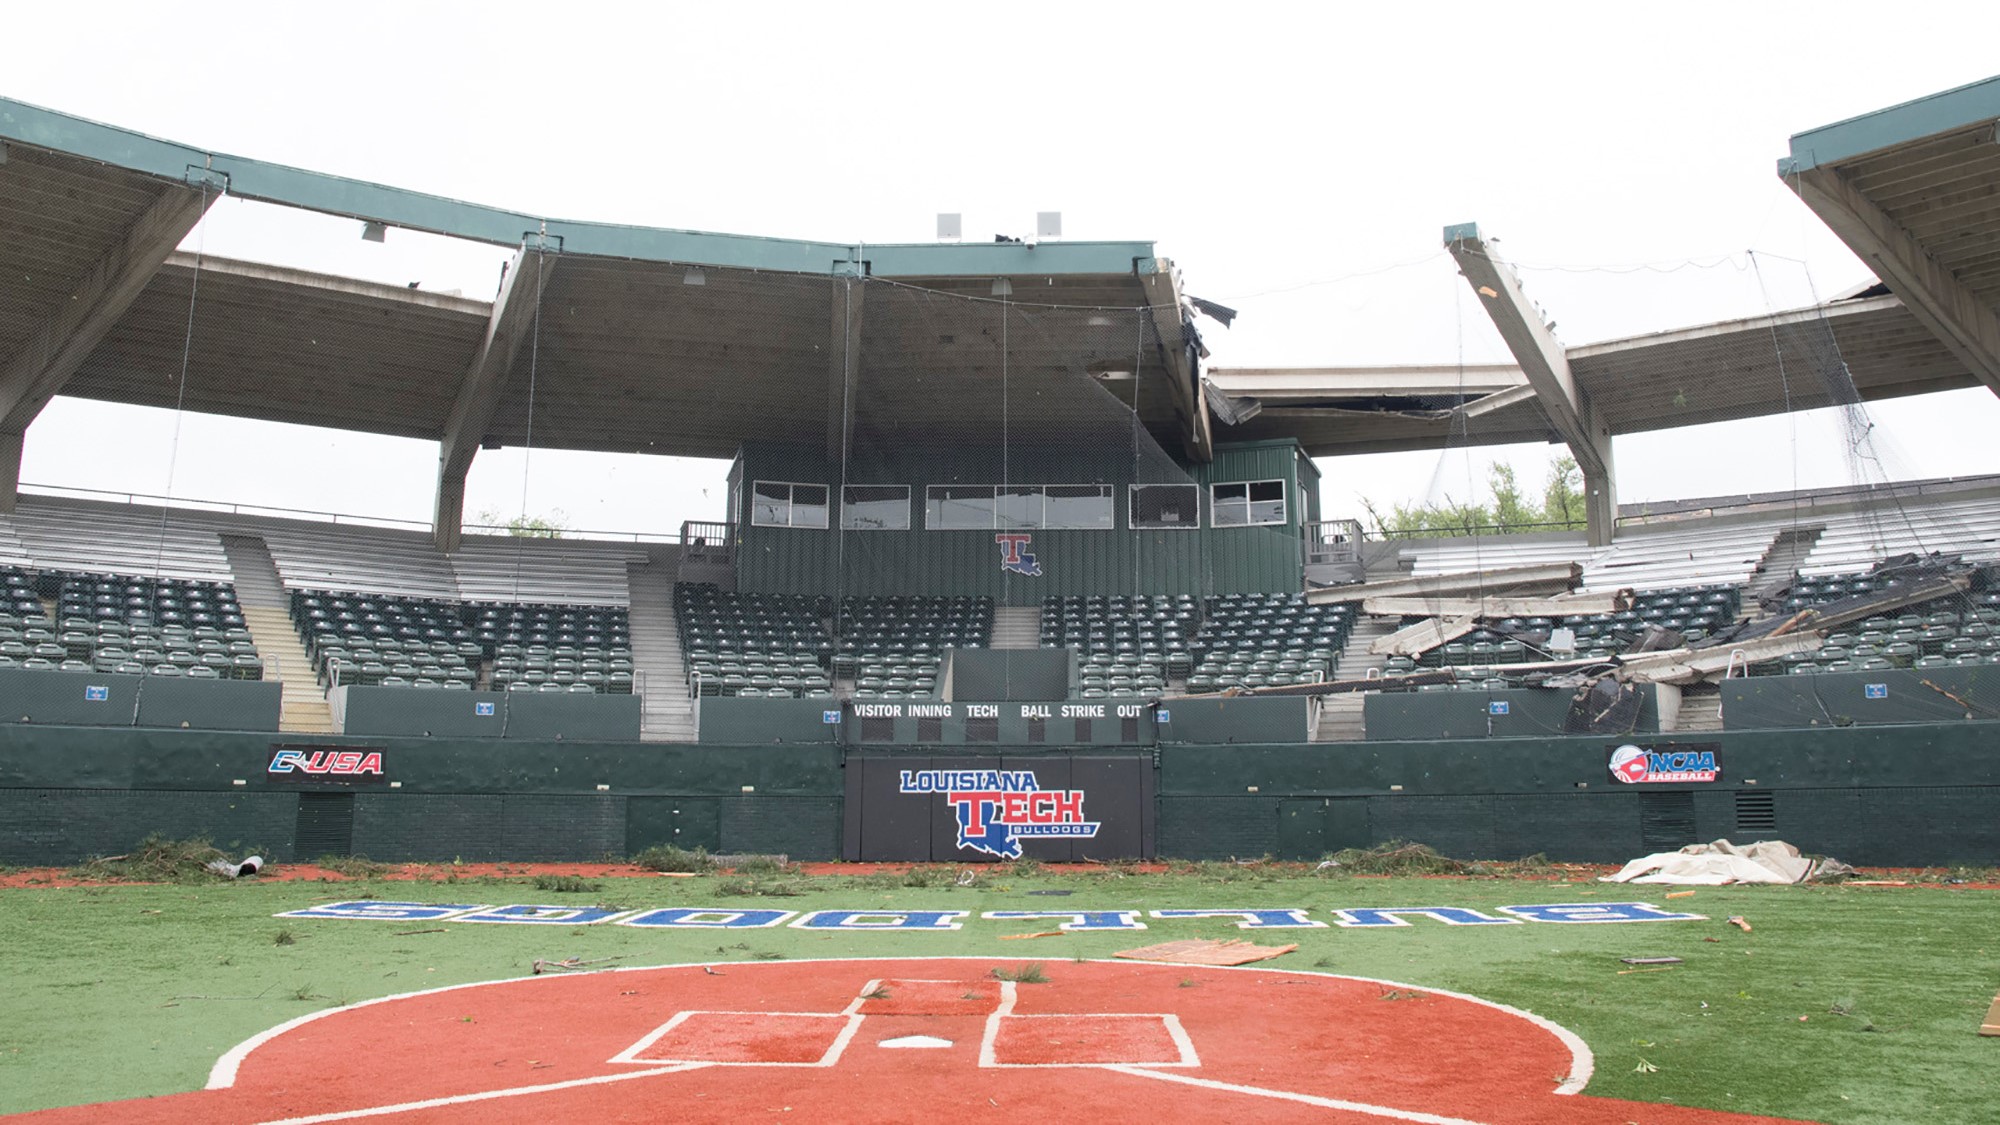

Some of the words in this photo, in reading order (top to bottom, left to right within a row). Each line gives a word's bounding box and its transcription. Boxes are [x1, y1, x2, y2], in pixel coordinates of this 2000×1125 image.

[854, 705, 902, 717] VISITOR
[908, 705, 951, 717] INNING
[967, 705, 998, 717] TECH
[1021, 705, 1051, 718] BALL
[1061, 705, 1104, 718] STRIKE
[1117, 705, 1141, 718] OUT
[1650, 752, 1715, 772] NCAA
[900, 770, 1039, 793] LOUISIANA
[1648, 772, 1712, 781] BASEBALL
[948, 791, 1084, 837] TECH
[1013, 825, 1092, 836] BULLDOGS
[274, 900, 1706, 930] BULLDOGS
